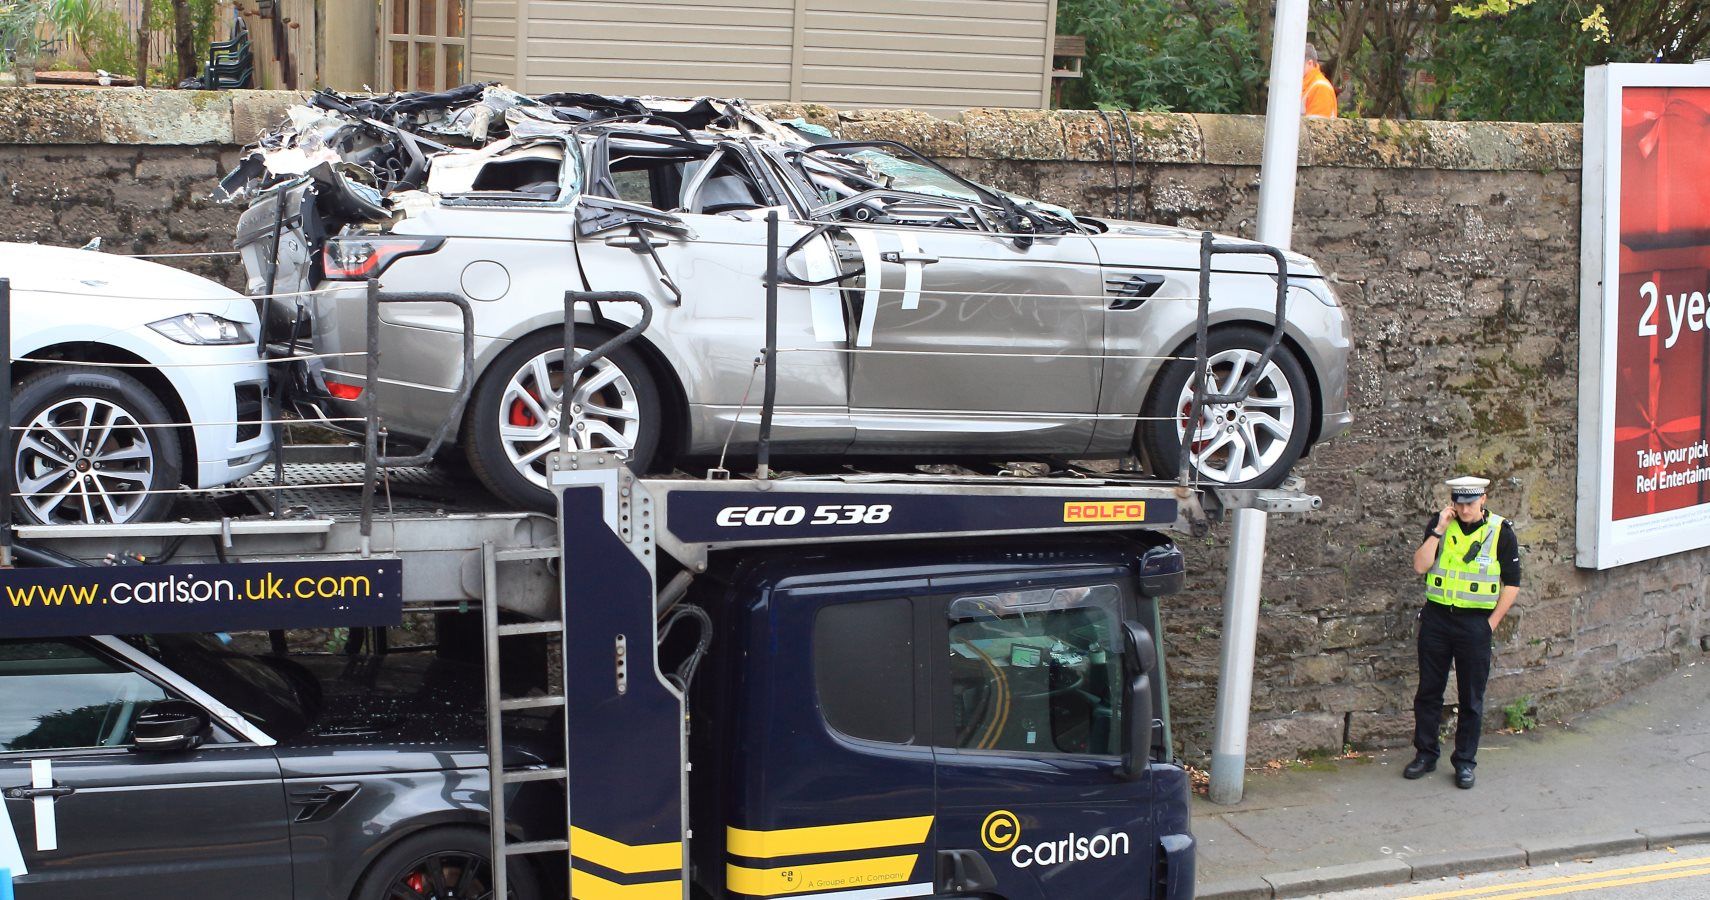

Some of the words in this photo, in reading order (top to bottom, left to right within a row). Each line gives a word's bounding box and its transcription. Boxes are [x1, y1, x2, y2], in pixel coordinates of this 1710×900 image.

[1638, 281, 1658, 337] 2
[1664, 291, 1710, 349] ye
[1637, 448, 1662, 468] Take
[1663, 447, 1687, 469] your
[1688, 439, 1709, 464] pick
[1636, 473, 1657, 493] Red
[716, 505, 806, 527] EGO
[810, 504, 892, 525] 538
[1067, 505, 1141, 518] ROLFO
[6, 572, 370, 607] www.carlson.uk.com
[1011, 832, 1129, 868] carlson
[816, 878, 846, 887] Groupe
[848, 875, 863, 884] CAT
[866, 872, 904, 881] Company
